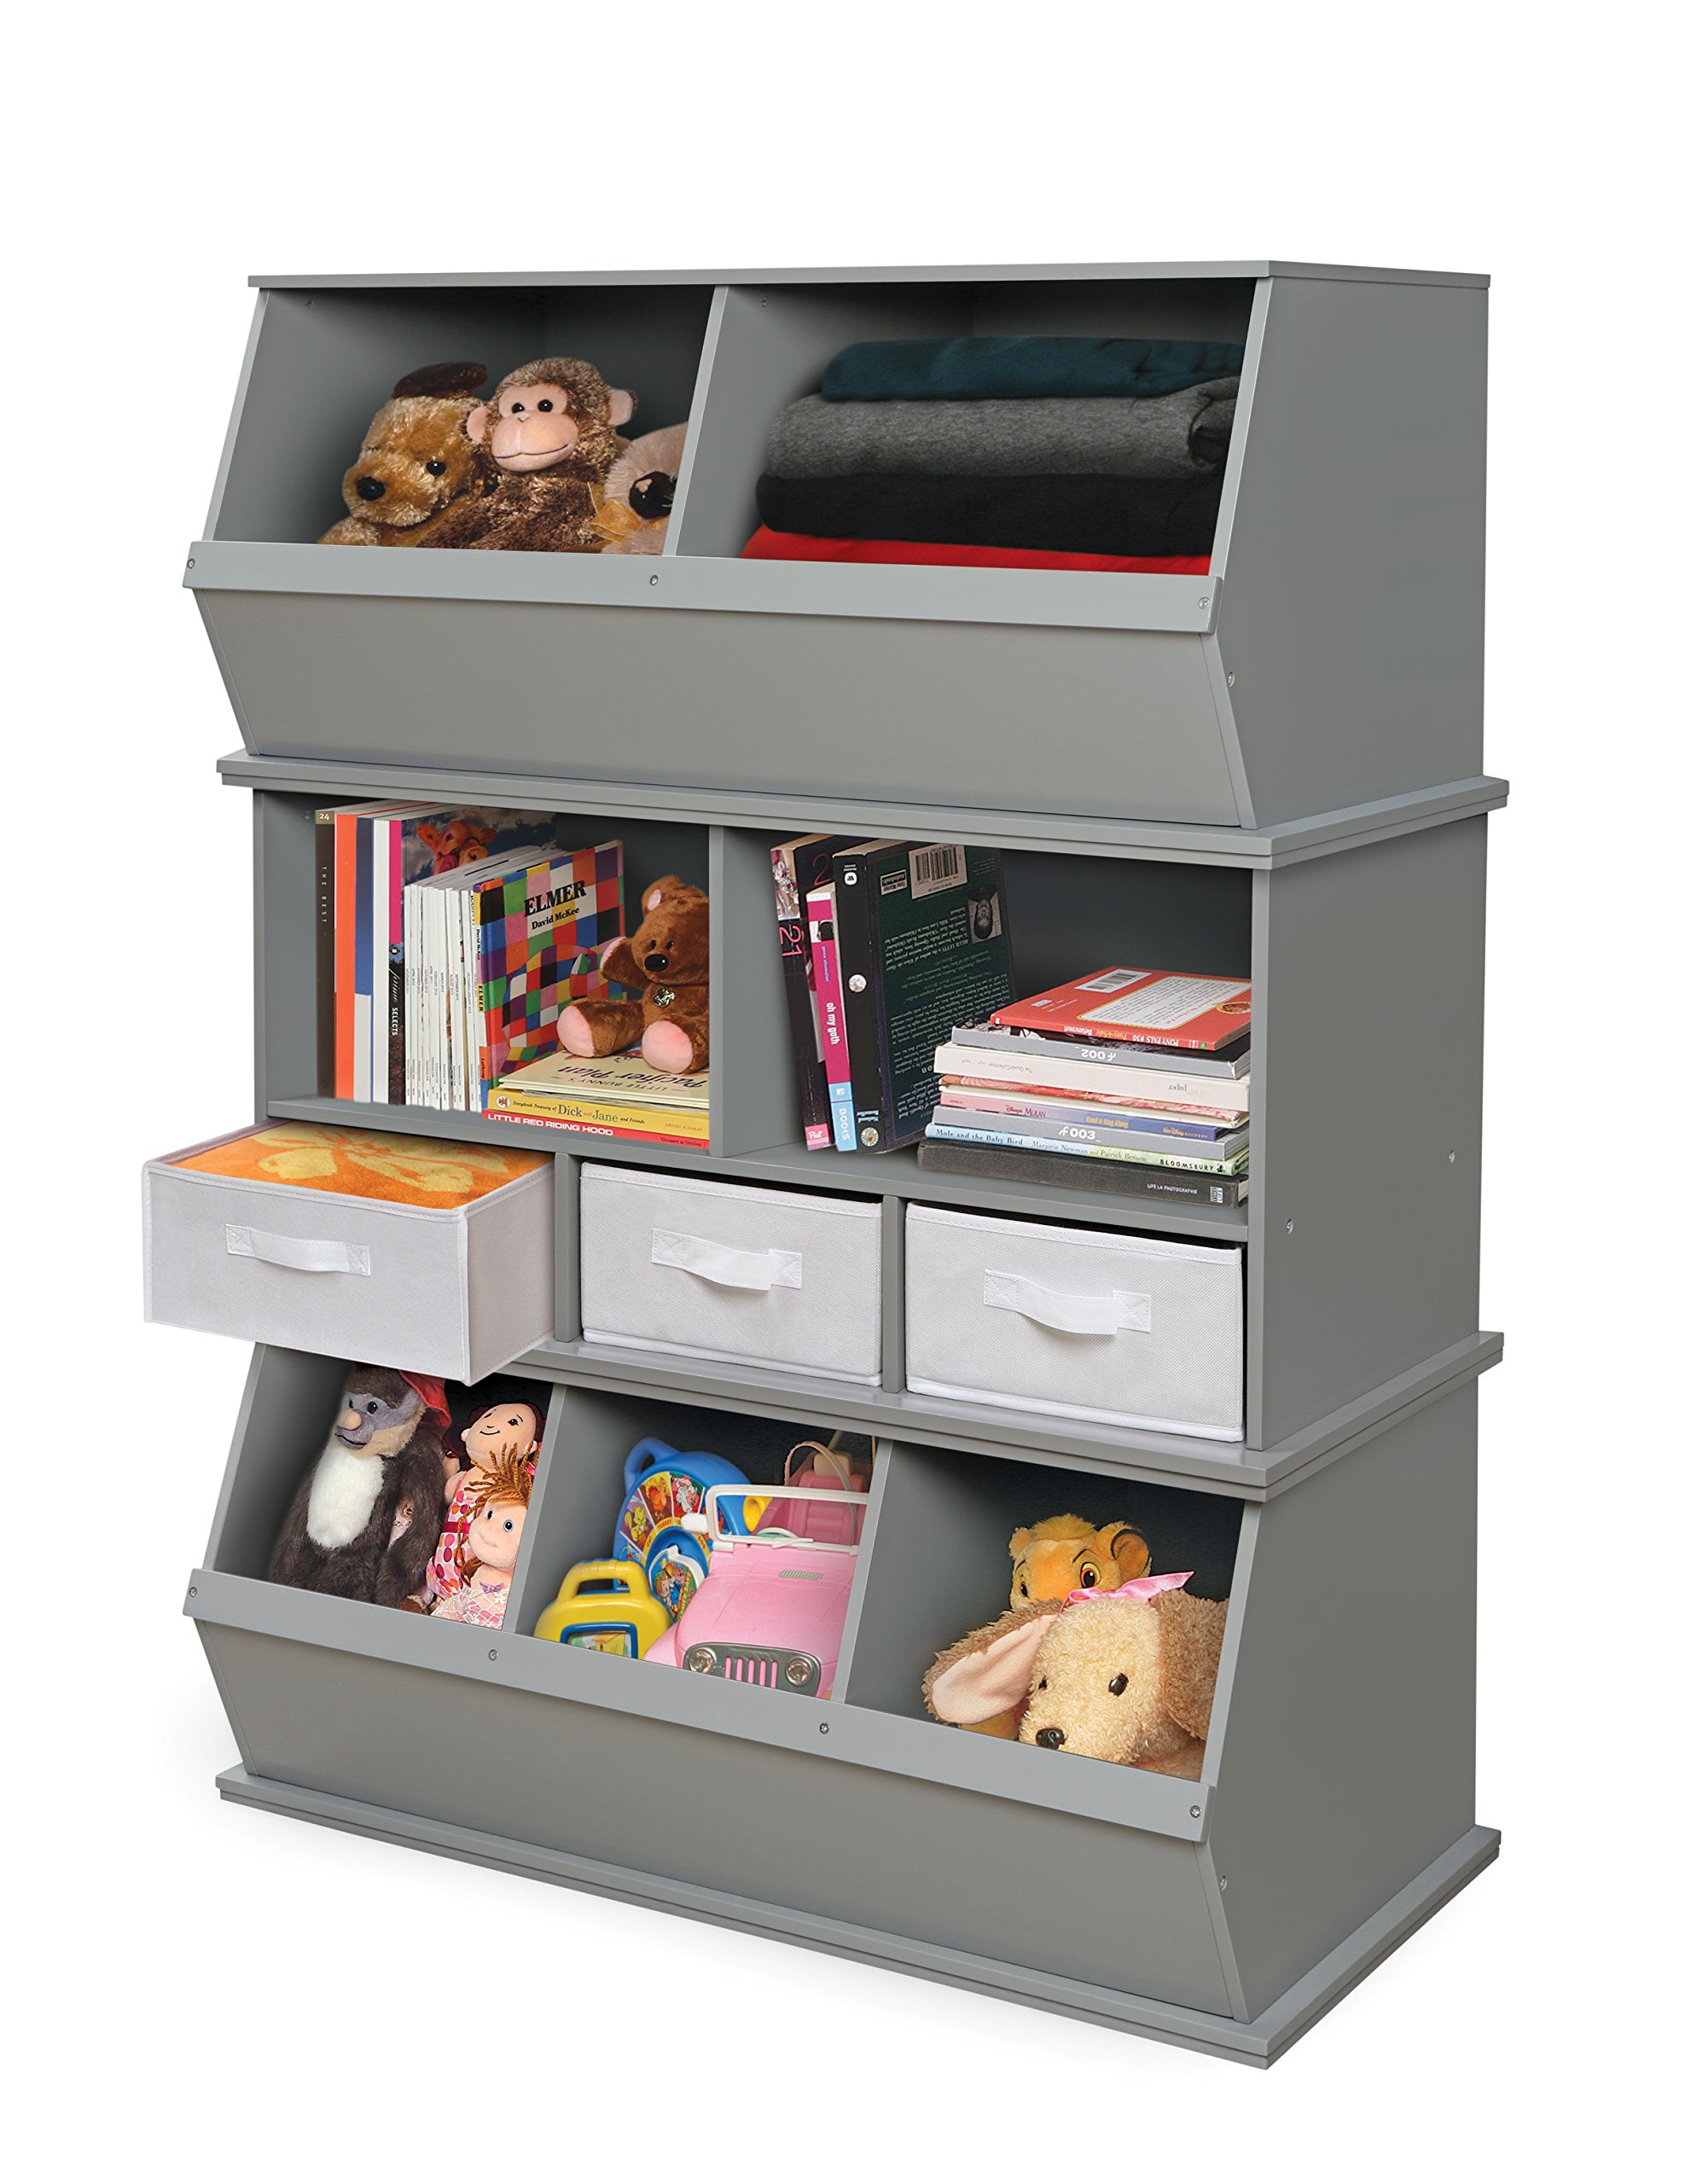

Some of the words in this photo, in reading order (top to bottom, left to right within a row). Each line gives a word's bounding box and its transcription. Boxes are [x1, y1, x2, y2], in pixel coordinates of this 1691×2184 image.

[524, 880, 587, 917] ELMER
[532, 915, 554, 930] David
[555, 908, 580, 921] McKee
[780, 926, 803, 956] 21
[826, 1002, 836, 1012] oh
[827, 1014, 836, 1025] my
[827, 1027, 840, 1045] goth
[1146, 1035, 1161, 1045] PALS
[1161, 1037, 1179, 1047] PONY
[557, 1066, 614, 1079] Plan
[614, 1072, 708, 1089] Pacifier
[558, 1105, 583, 1117] Dick
[592, 1110, 619, 1123] Jane
[487, 1113, 521, 1124] LITTLE
[522, 1118, 544, 1127] RED
[545, 1121, 580, 1131] RIDING
[582, 1126, 613, 1136] HOOD
[935, 1129, 954, 1137] Mole
[956, 1131, 970, 1140] and
[985, 1135, 1004, 1144] Baby
[1007, 1137, 1023, 1146] Bird
[1031, 1141, 1059, 1151] Marjorie
[1061, 1144, 1089, 1154] Newman
[1101, 1149, 1122, 1159] Patrick
[1159, 1159, 1213, 1171] BLOOMSBURY
[1164, 1185, 1198, 1194] PHOTOGRAPHIE
